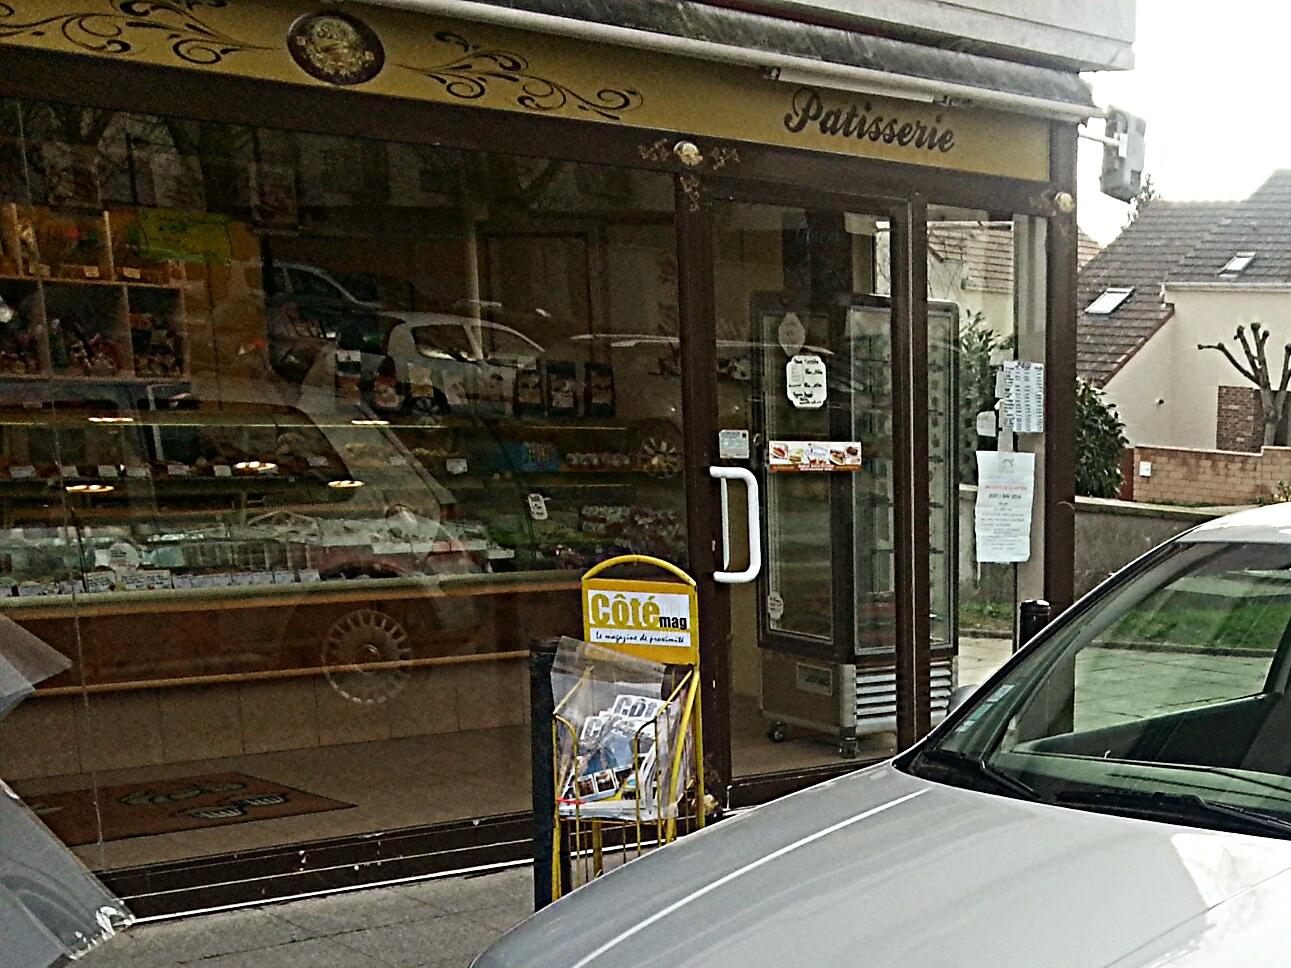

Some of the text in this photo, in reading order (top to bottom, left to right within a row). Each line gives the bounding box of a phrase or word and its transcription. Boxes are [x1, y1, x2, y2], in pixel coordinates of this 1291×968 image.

[783, 87, 955, 153] Patisserie
[591, 593, 688, 630] Côté mag
[595, 631, 602, 640] Le
[605, 634, 637, 644] magazine
[640, 633, 648, 641] de
